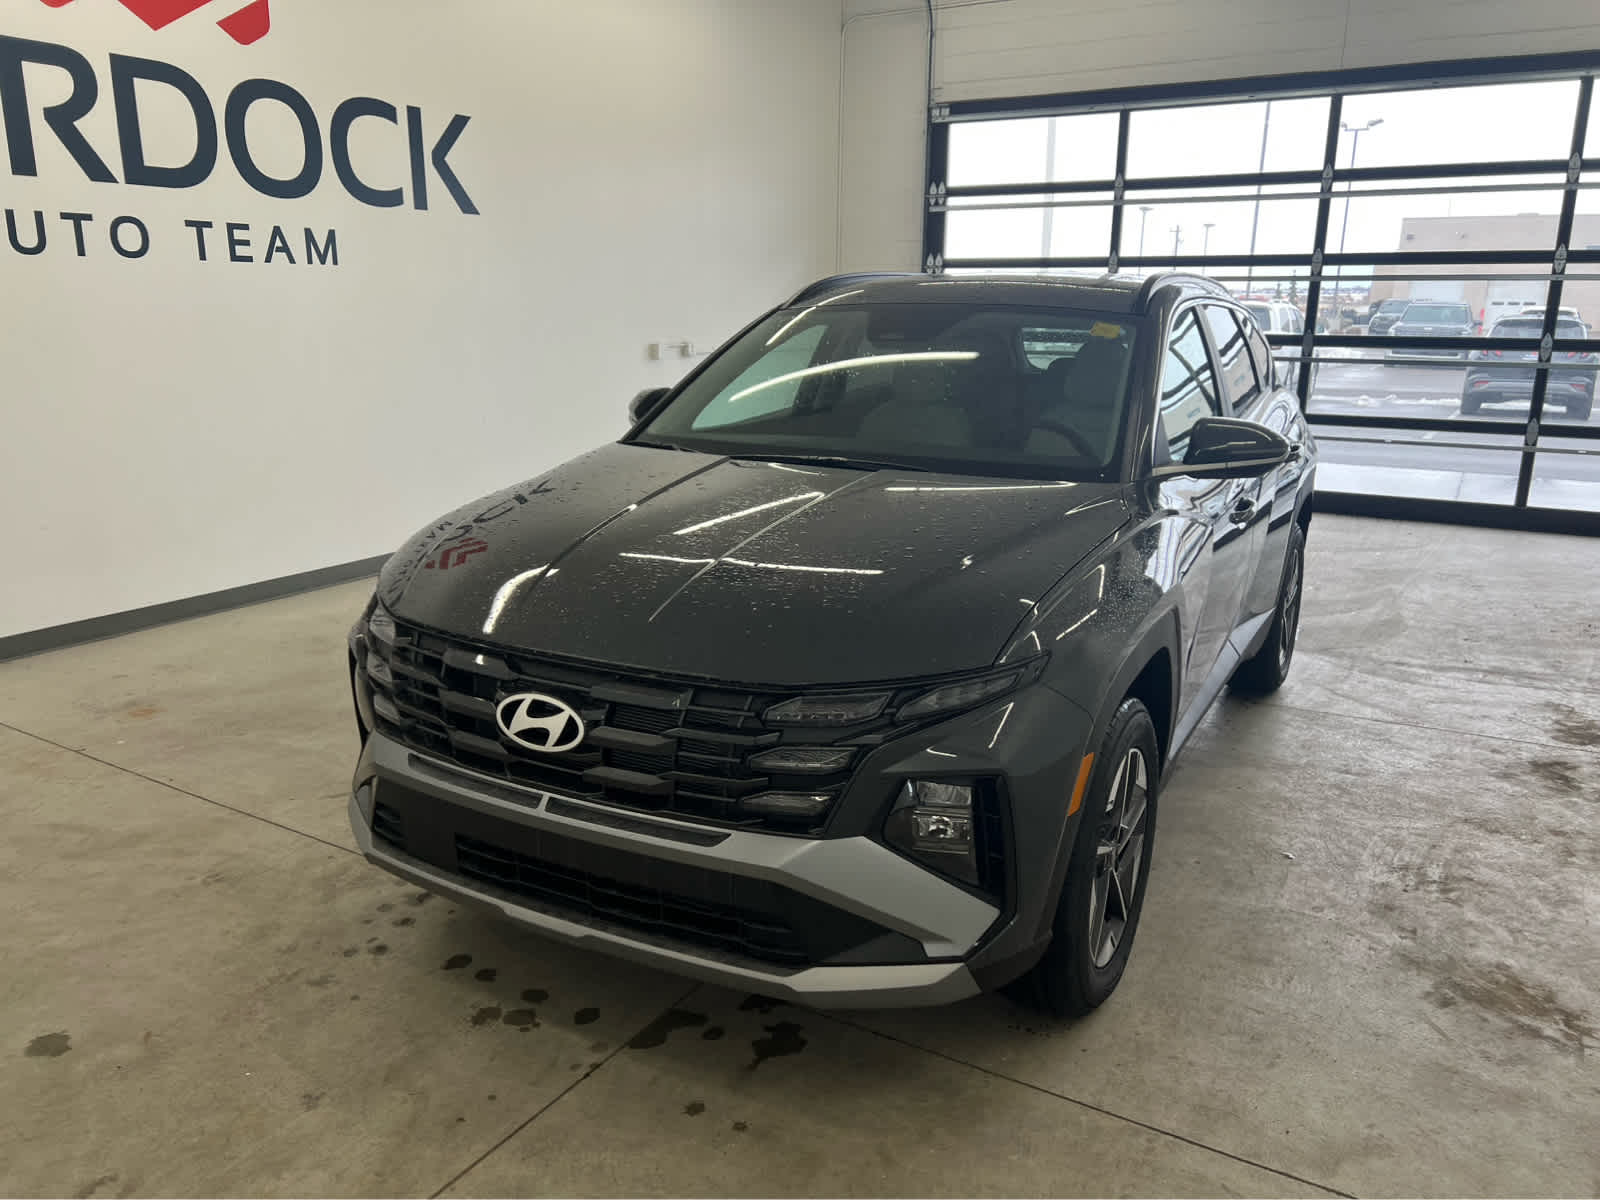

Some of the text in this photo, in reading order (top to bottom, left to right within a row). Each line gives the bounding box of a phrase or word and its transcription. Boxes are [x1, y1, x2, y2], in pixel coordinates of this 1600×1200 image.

[0, 34, 480, 216] RDOCK
[4, 208, 339, 266] UTO TEAM
